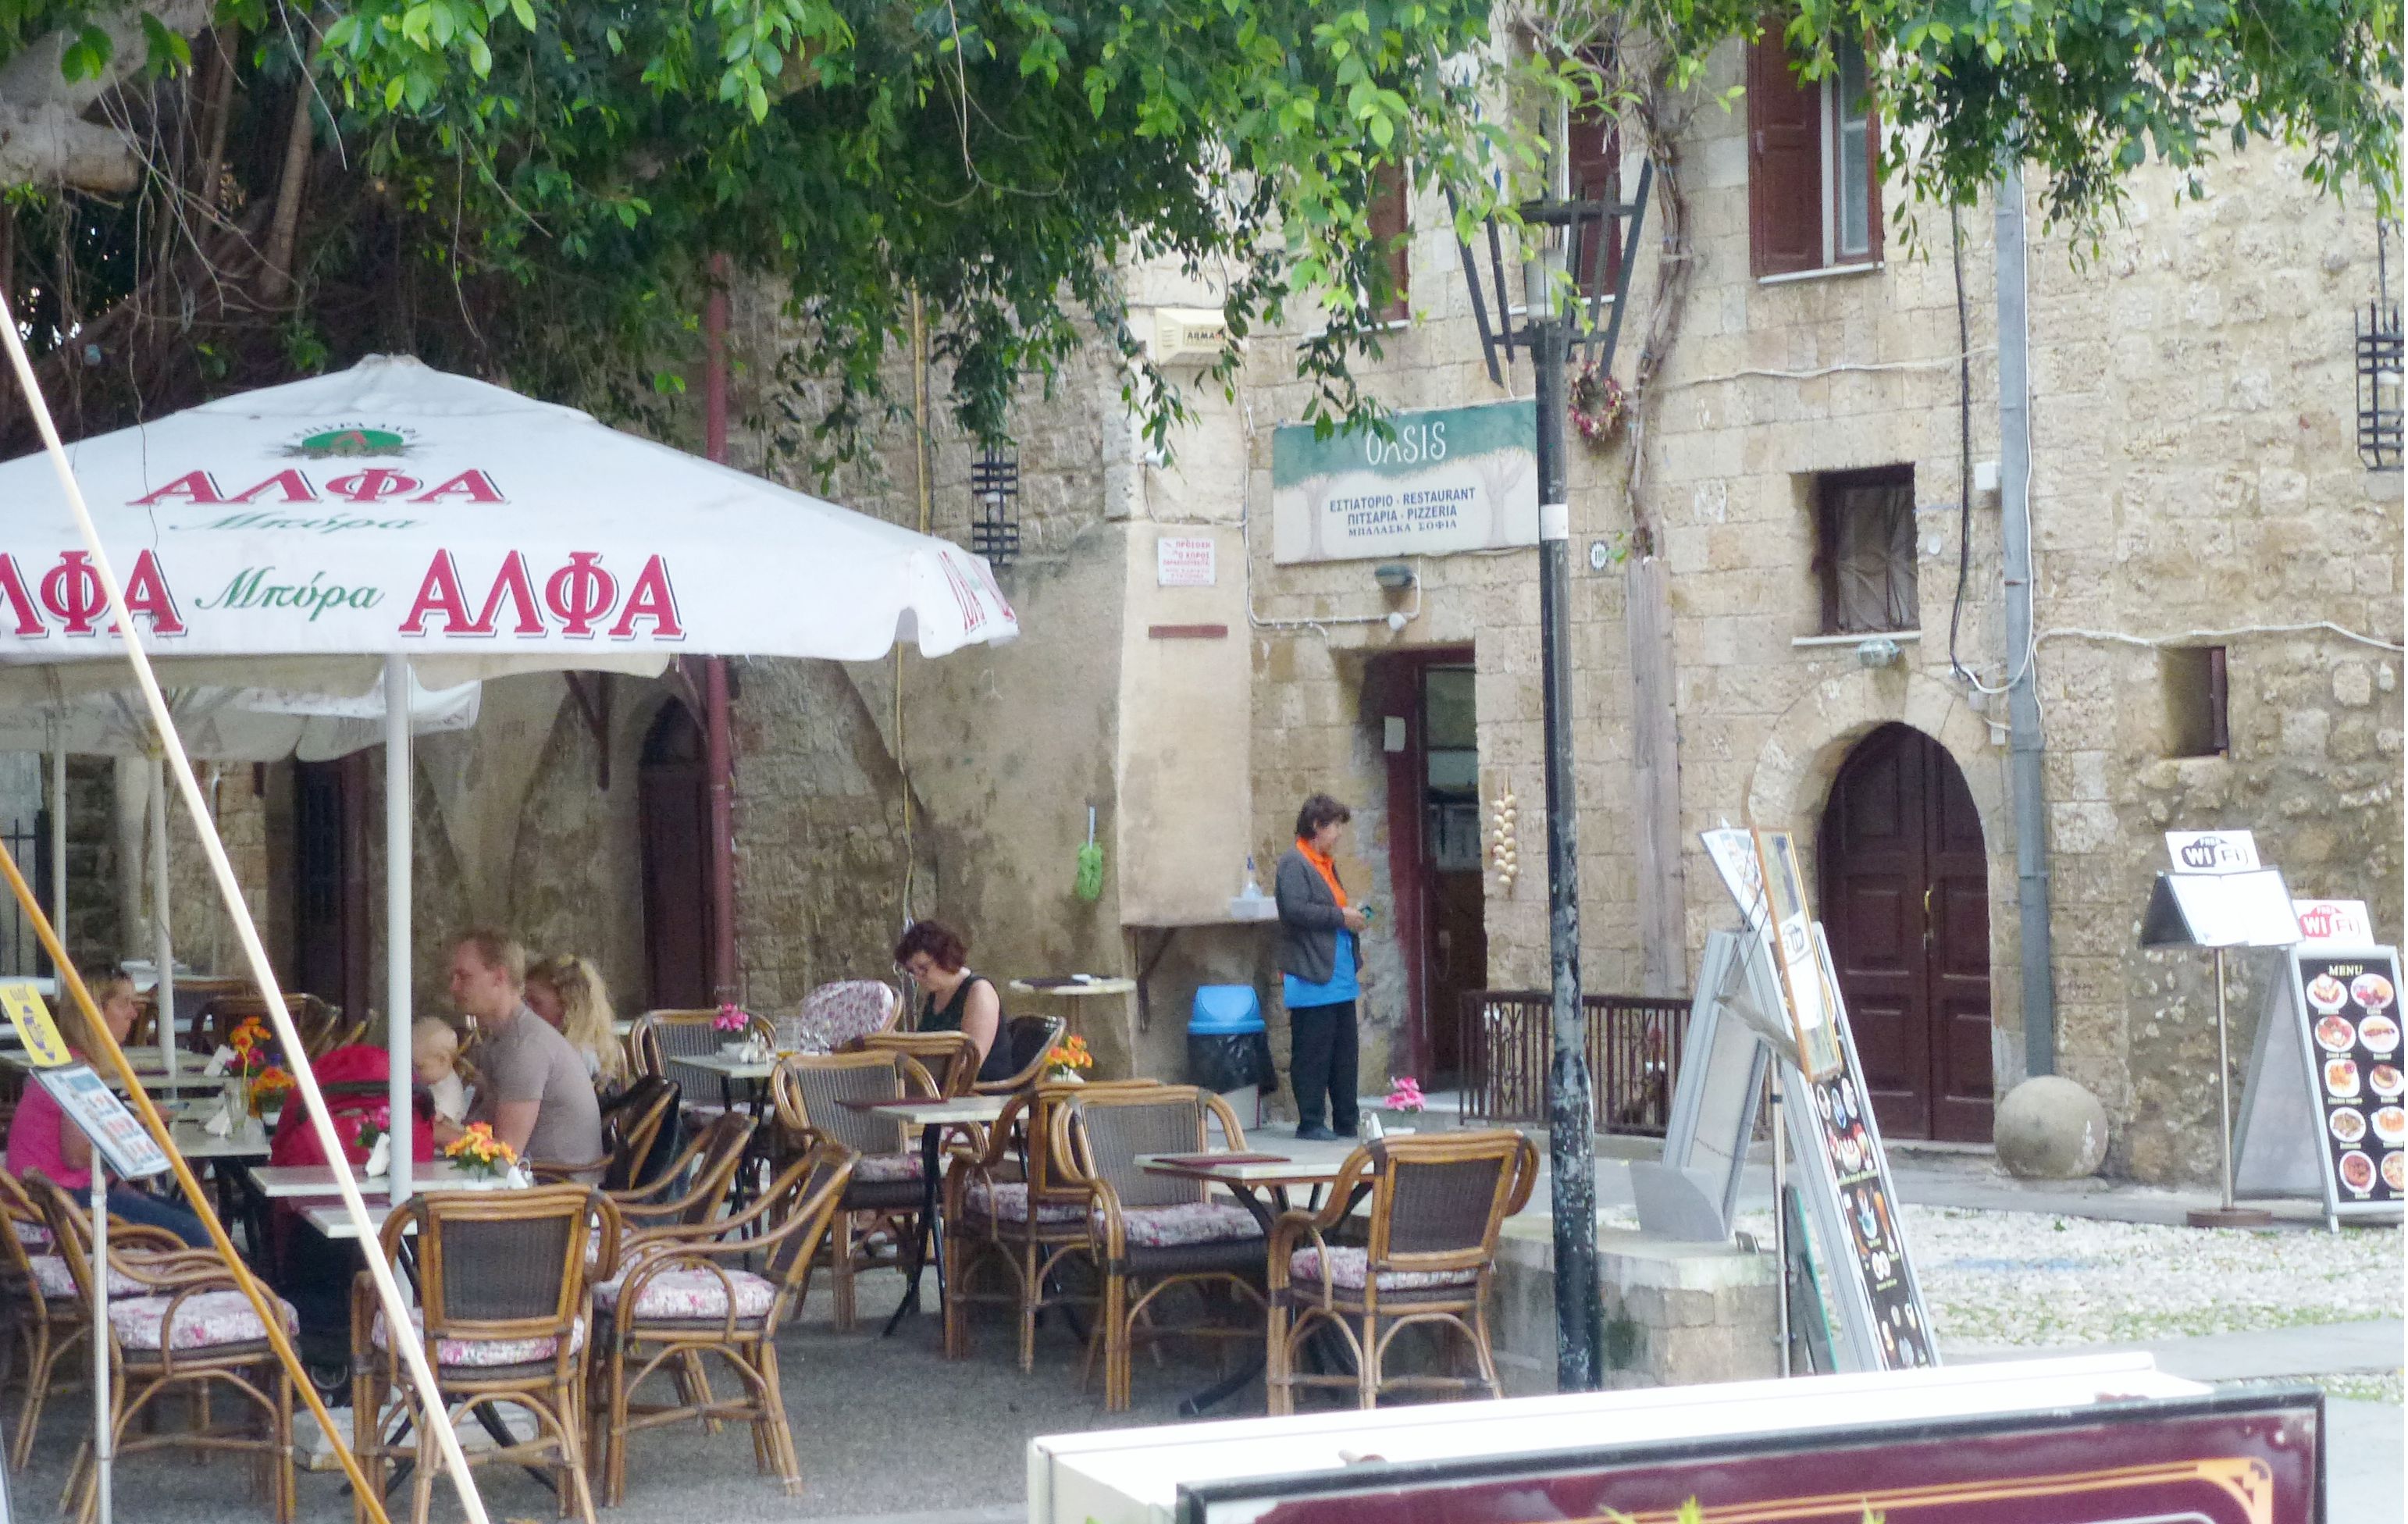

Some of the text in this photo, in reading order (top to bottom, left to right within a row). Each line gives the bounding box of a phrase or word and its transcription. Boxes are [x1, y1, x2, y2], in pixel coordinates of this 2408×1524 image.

[126, 468, 509, 505] ΑΛΦΑ
[1330, 487, 1477, 512] ΕΣΤΙΑΤΟΡΙΟ RESTAURANT
[1348, 504, 1458, 525] ΠΙΤΣΑΡΙΑ PIZZERIA
[0, 547, 686, 641] ΛΦΑ Μπύρα ΑΛΦΑ
[2328, 965, 2363, 977] MENU
